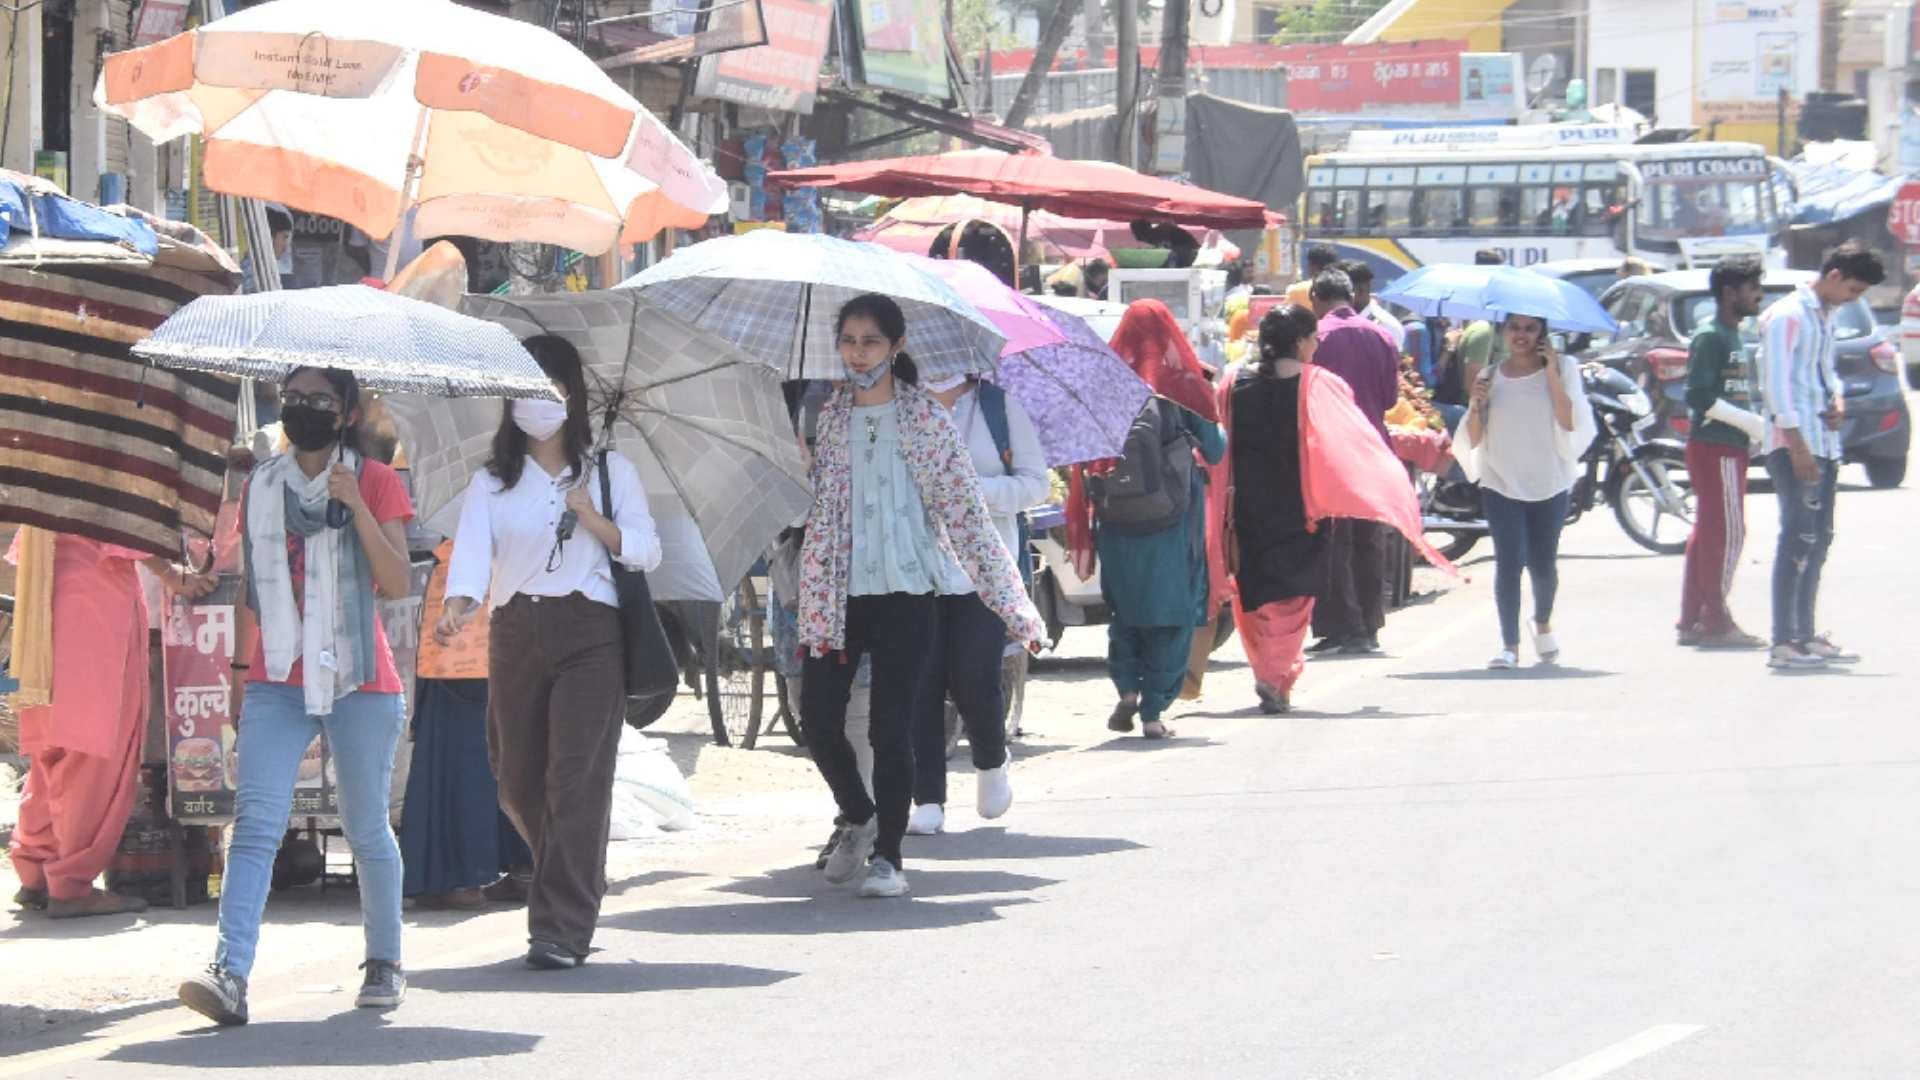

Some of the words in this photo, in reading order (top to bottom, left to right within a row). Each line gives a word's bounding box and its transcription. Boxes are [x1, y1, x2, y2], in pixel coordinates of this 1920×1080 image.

[1559, 127, 1618, 141] PURI
[1641, 162, 1694, 177] PURI
[1698, 159, 1767, 176] COACH
[1889, 200, 1920, 224] STO
[174, 674, 231, 738] कुल्चे
